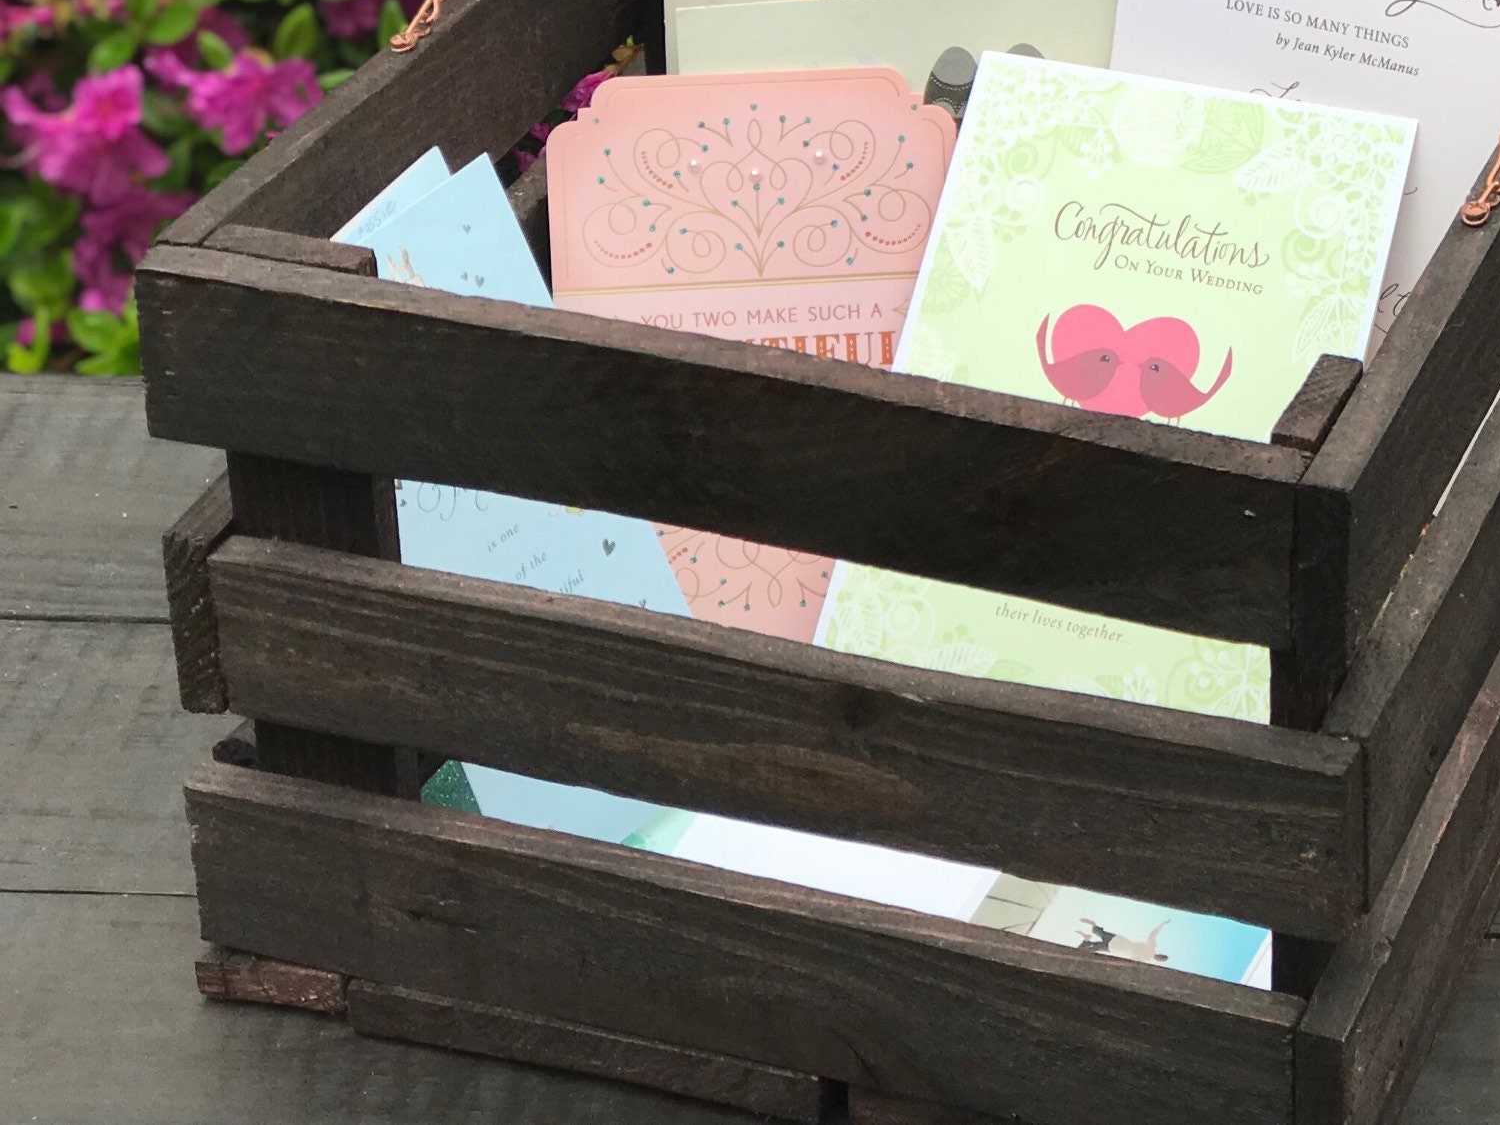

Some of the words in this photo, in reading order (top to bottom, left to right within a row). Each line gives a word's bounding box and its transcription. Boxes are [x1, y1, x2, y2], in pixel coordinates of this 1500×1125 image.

[1267, 6, 1280, 20] IS
[1283, 10, 1302, 25] SO
[1305, 15, 1350, 36] MANY
[1354, 25, 1410, 49] THINGS
[1275, 33, 1291, 50] by
[1292, 37, 1320, 54] Jean
[1323, 43, 1356, 62] Kyler
[1358, 52, 1420, 77] McManus
[1054, 200, 1270, 271] Congratulations
[640, 314, 683, 329] YOU
[692, 310, 737, 327] TWO
[747, 307, 798, 325] MAKE
[808, 304, 860, 321] SUCH
[871, 303, 882, 318] A
[487, 539, 497, 553] is
[500, 524, 519, 543] one
[514, 562, 527, 581] of
[529, 551, 547, 570] the
[995, 602, 1030, 621] their
[1032, 609, 1063, 629] lives
